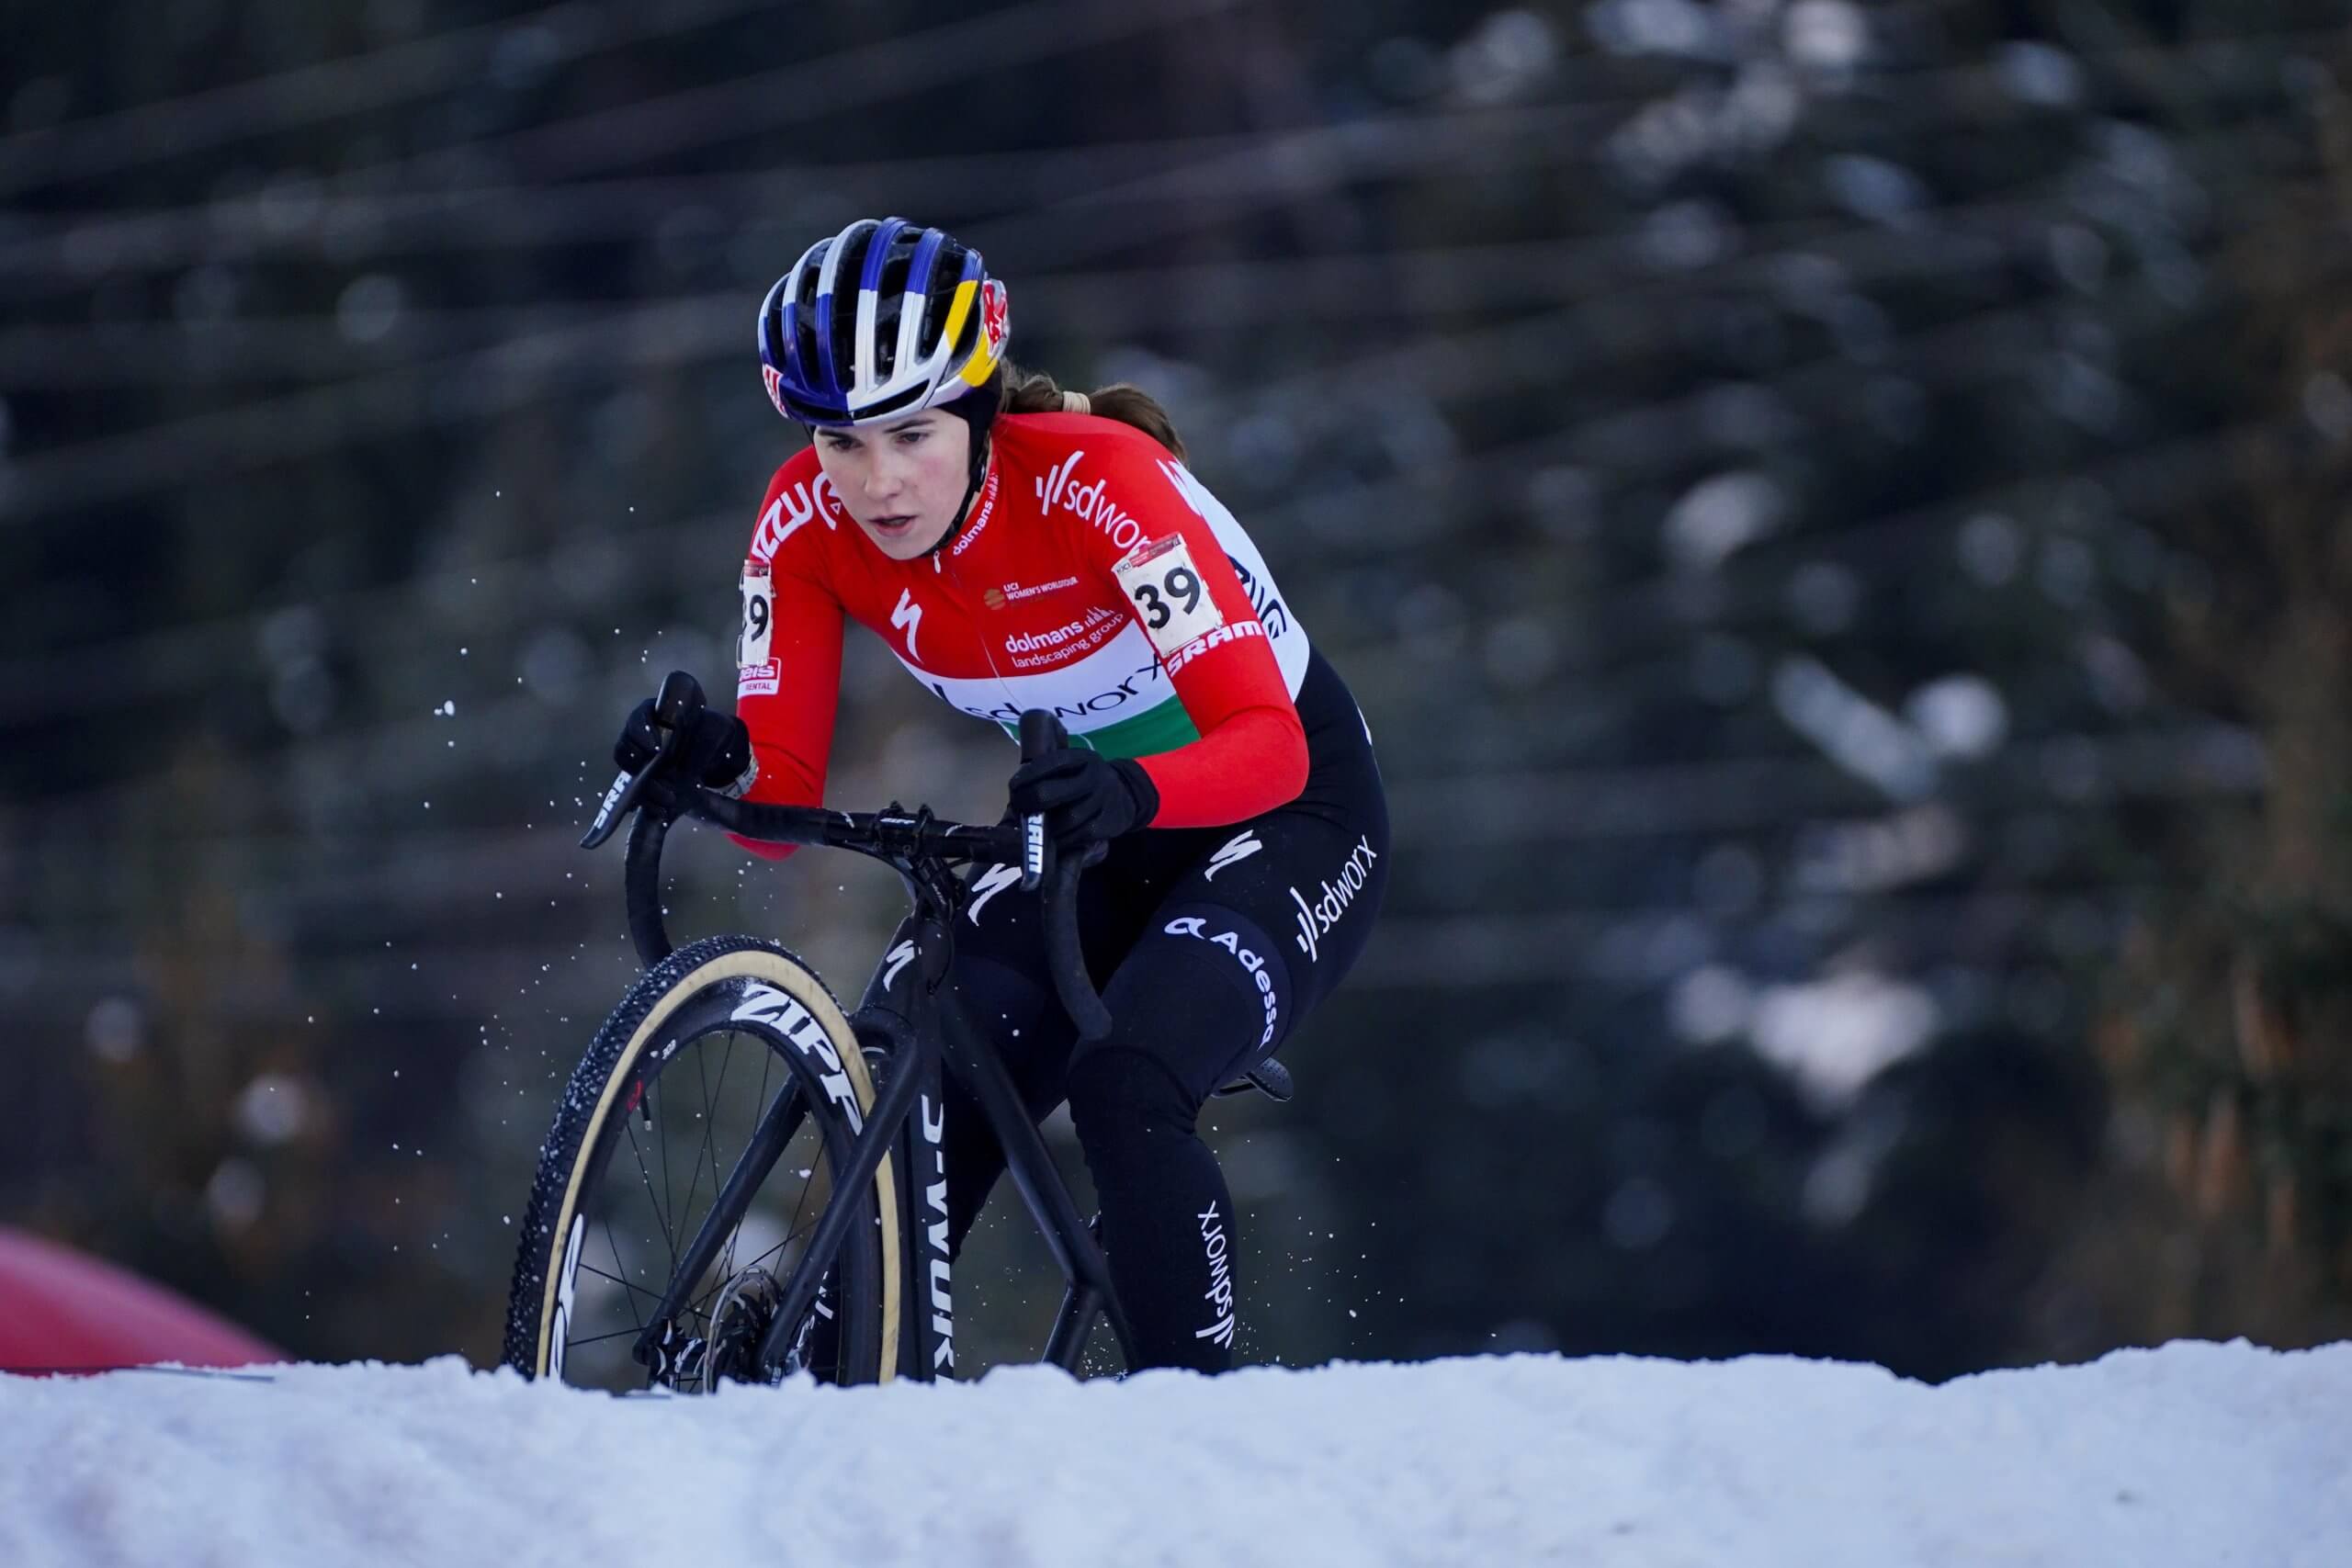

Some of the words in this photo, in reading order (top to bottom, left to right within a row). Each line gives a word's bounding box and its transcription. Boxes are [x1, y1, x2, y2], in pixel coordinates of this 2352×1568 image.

[953, 500, 994, 557] dolmans
[1064, 479, 1152, 558] sdwor
[1003, 581, 1019, 592] UCI
[1006, 585, 1042, 601] WOMEN'S
[1040, 576, 1079, 593] WORLDTOUR
[1134, 568, 1201, 630] 39
[742, 594, 769, 643] 9
[1005, 619, 1084, 654] dolmans
[1012, 637, 1091, 669] landscaping
[1089, 612, 1125, 645] group
[1166, 620, 1264, 676] SRAM
[594, 770, 632, 829] SRA
[1315, 834, 1377, 934] sdworx
[730, 984, 863, 1136] ZIPP
[1197, 1200, 1233, 1318] sdworx
